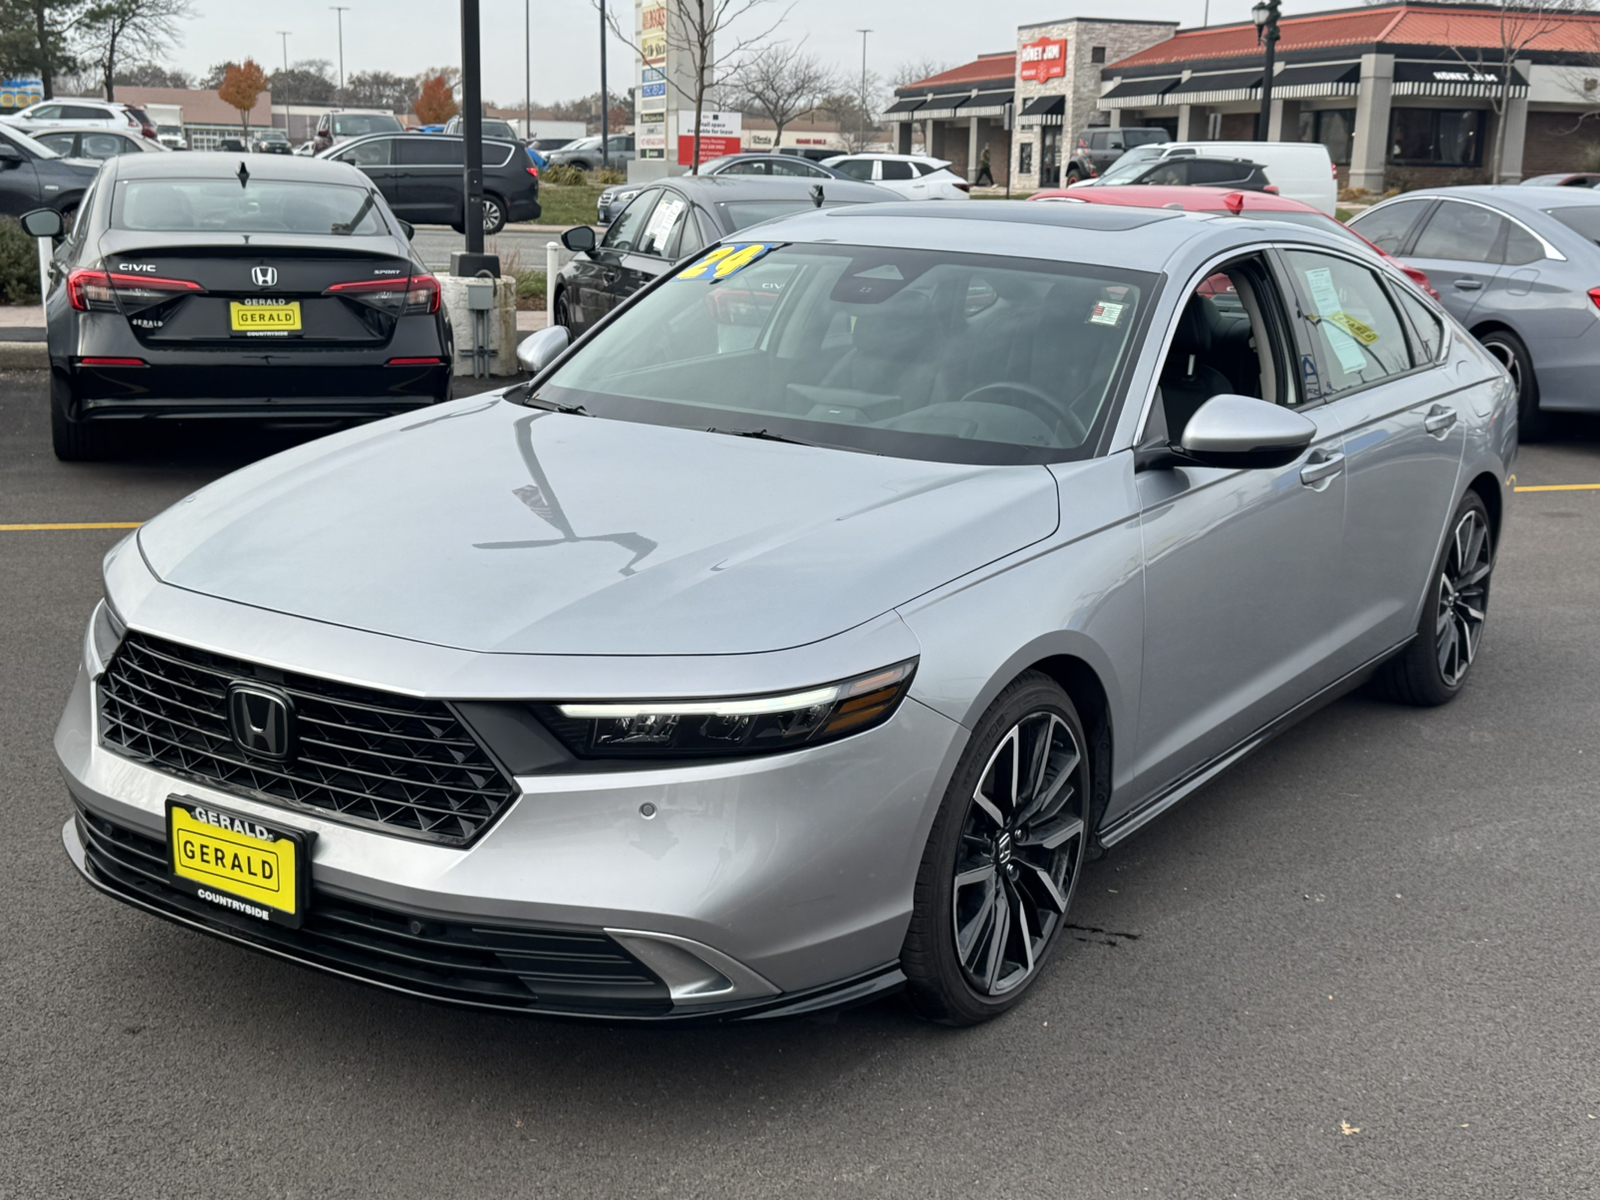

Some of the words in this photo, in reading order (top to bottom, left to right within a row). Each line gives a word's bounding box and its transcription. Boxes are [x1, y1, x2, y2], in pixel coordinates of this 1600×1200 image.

[118, 263, 157, 272] CIVIC
[676, 244, 765, 280] 24
[240, 312, 292, 323] GERALD
[244, 298, 286, 306] GERALD
[194, 806, 269, 841] GERALD
[183, 839, 274, 880] GERALD
[197, 888, 270, 921] COUNTRYSIDE
